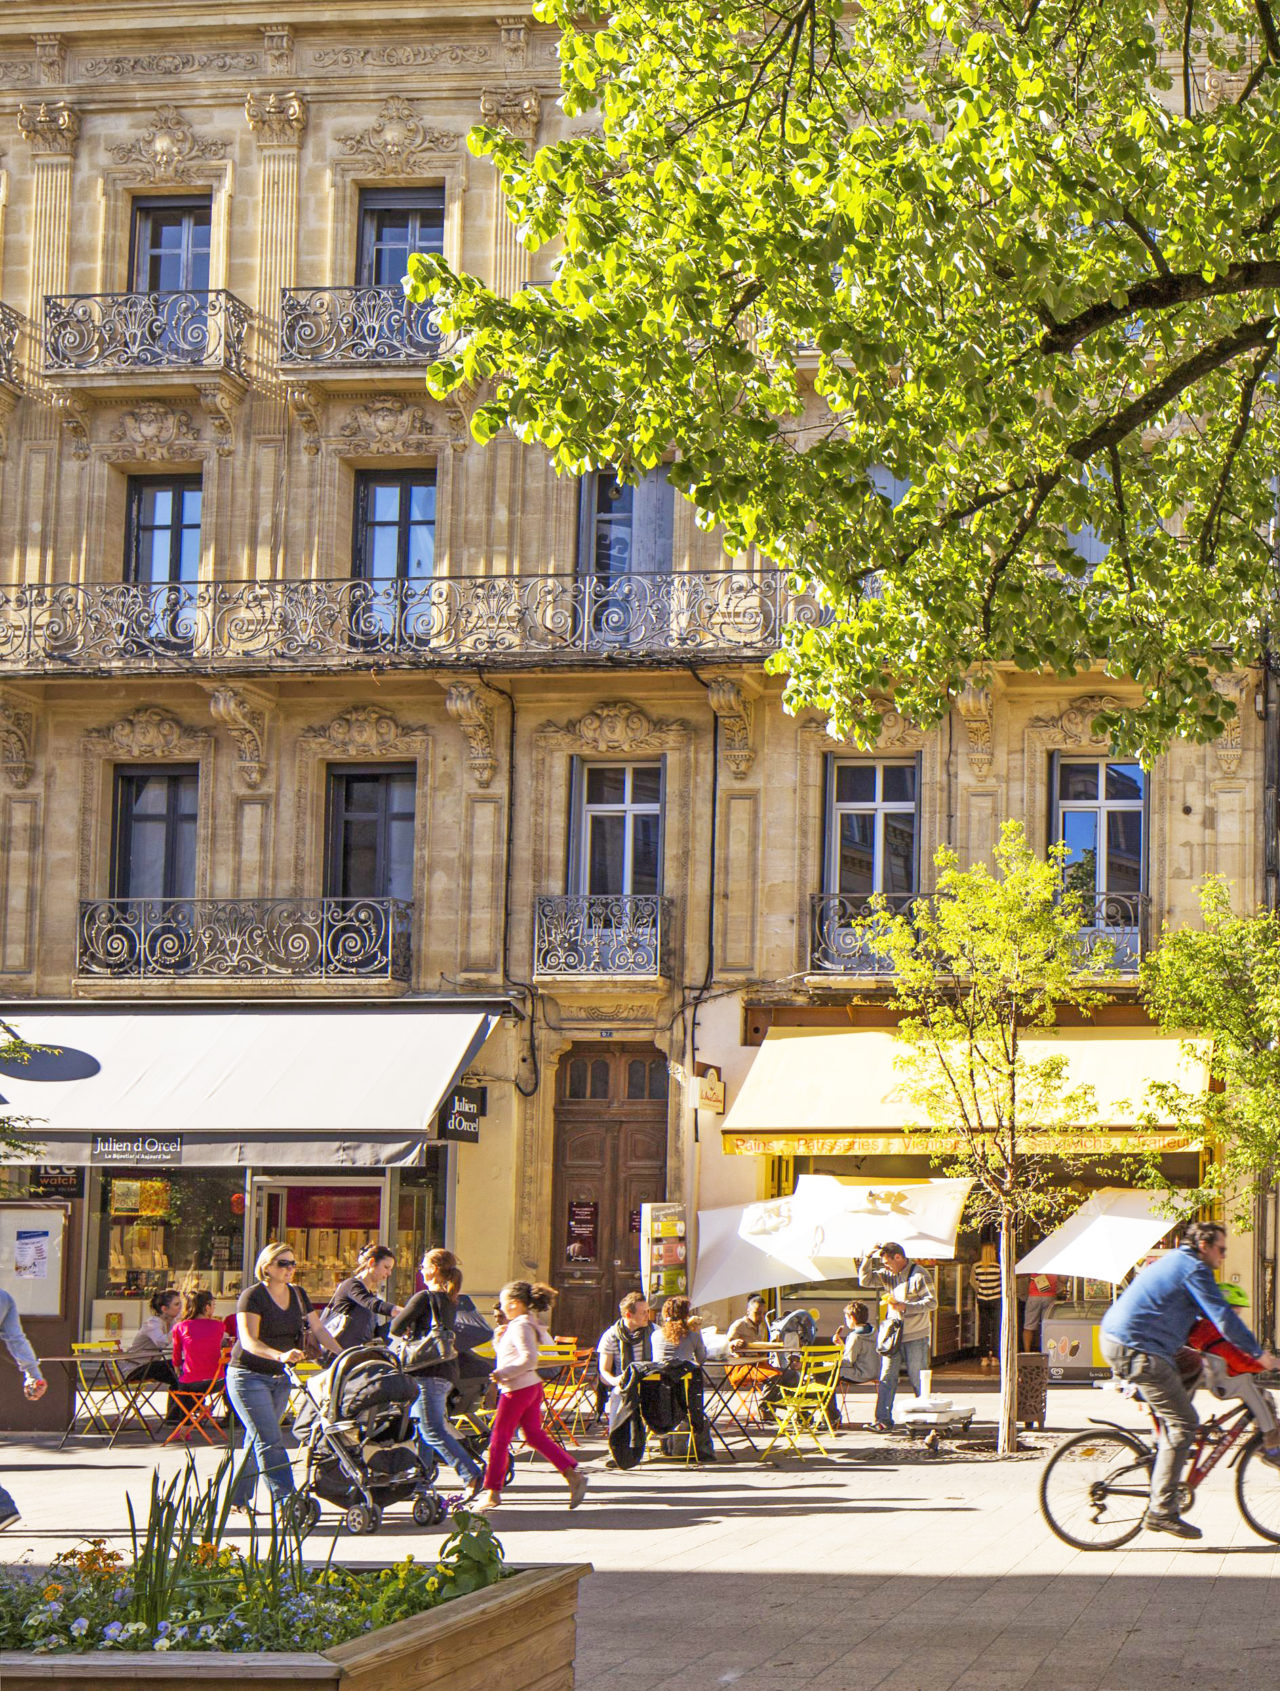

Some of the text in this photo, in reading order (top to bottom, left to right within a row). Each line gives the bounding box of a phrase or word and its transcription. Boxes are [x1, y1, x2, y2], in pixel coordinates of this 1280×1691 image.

[451, 1095, 477, 1113] Julien
[447, 1113, 479, 1132] d'Orcel
[93, 1137, 131, 1154] Julien
[735, 1138, 774, 1151] Pains
[40, 1176, 77, 1184] watch
